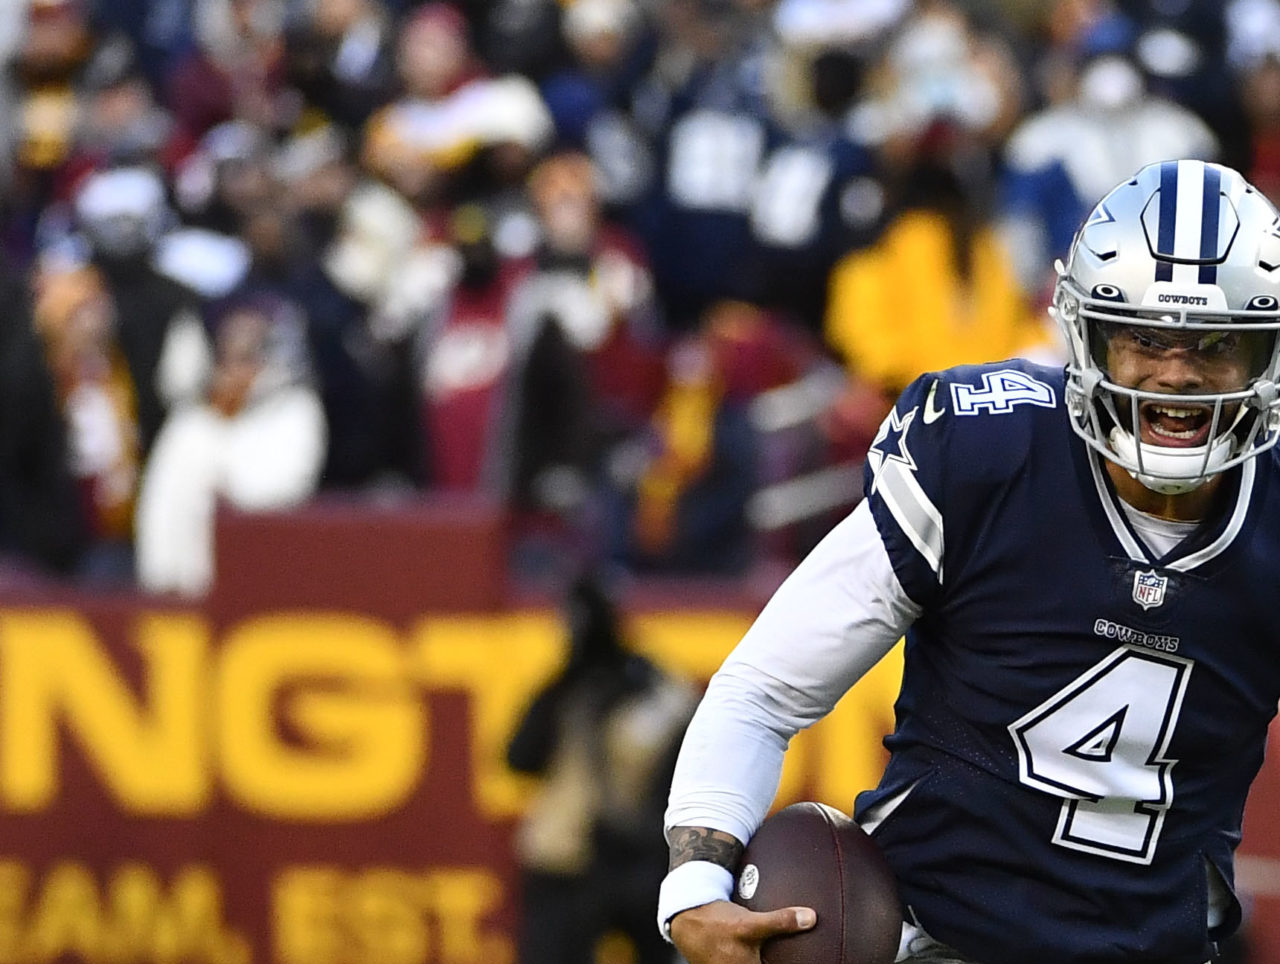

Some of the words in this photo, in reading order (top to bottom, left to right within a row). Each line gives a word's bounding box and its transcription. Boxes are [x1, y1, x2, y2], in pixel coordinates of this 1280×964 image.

[1158, 293, 1208, 306] COWBOYS
[949, 369, 1056, 416] 4
[1138, 586, 1159, 602] NFL
[1094, 618, 1180, 652] COWBOYS
[1007, 643, 1196, 866] 4
